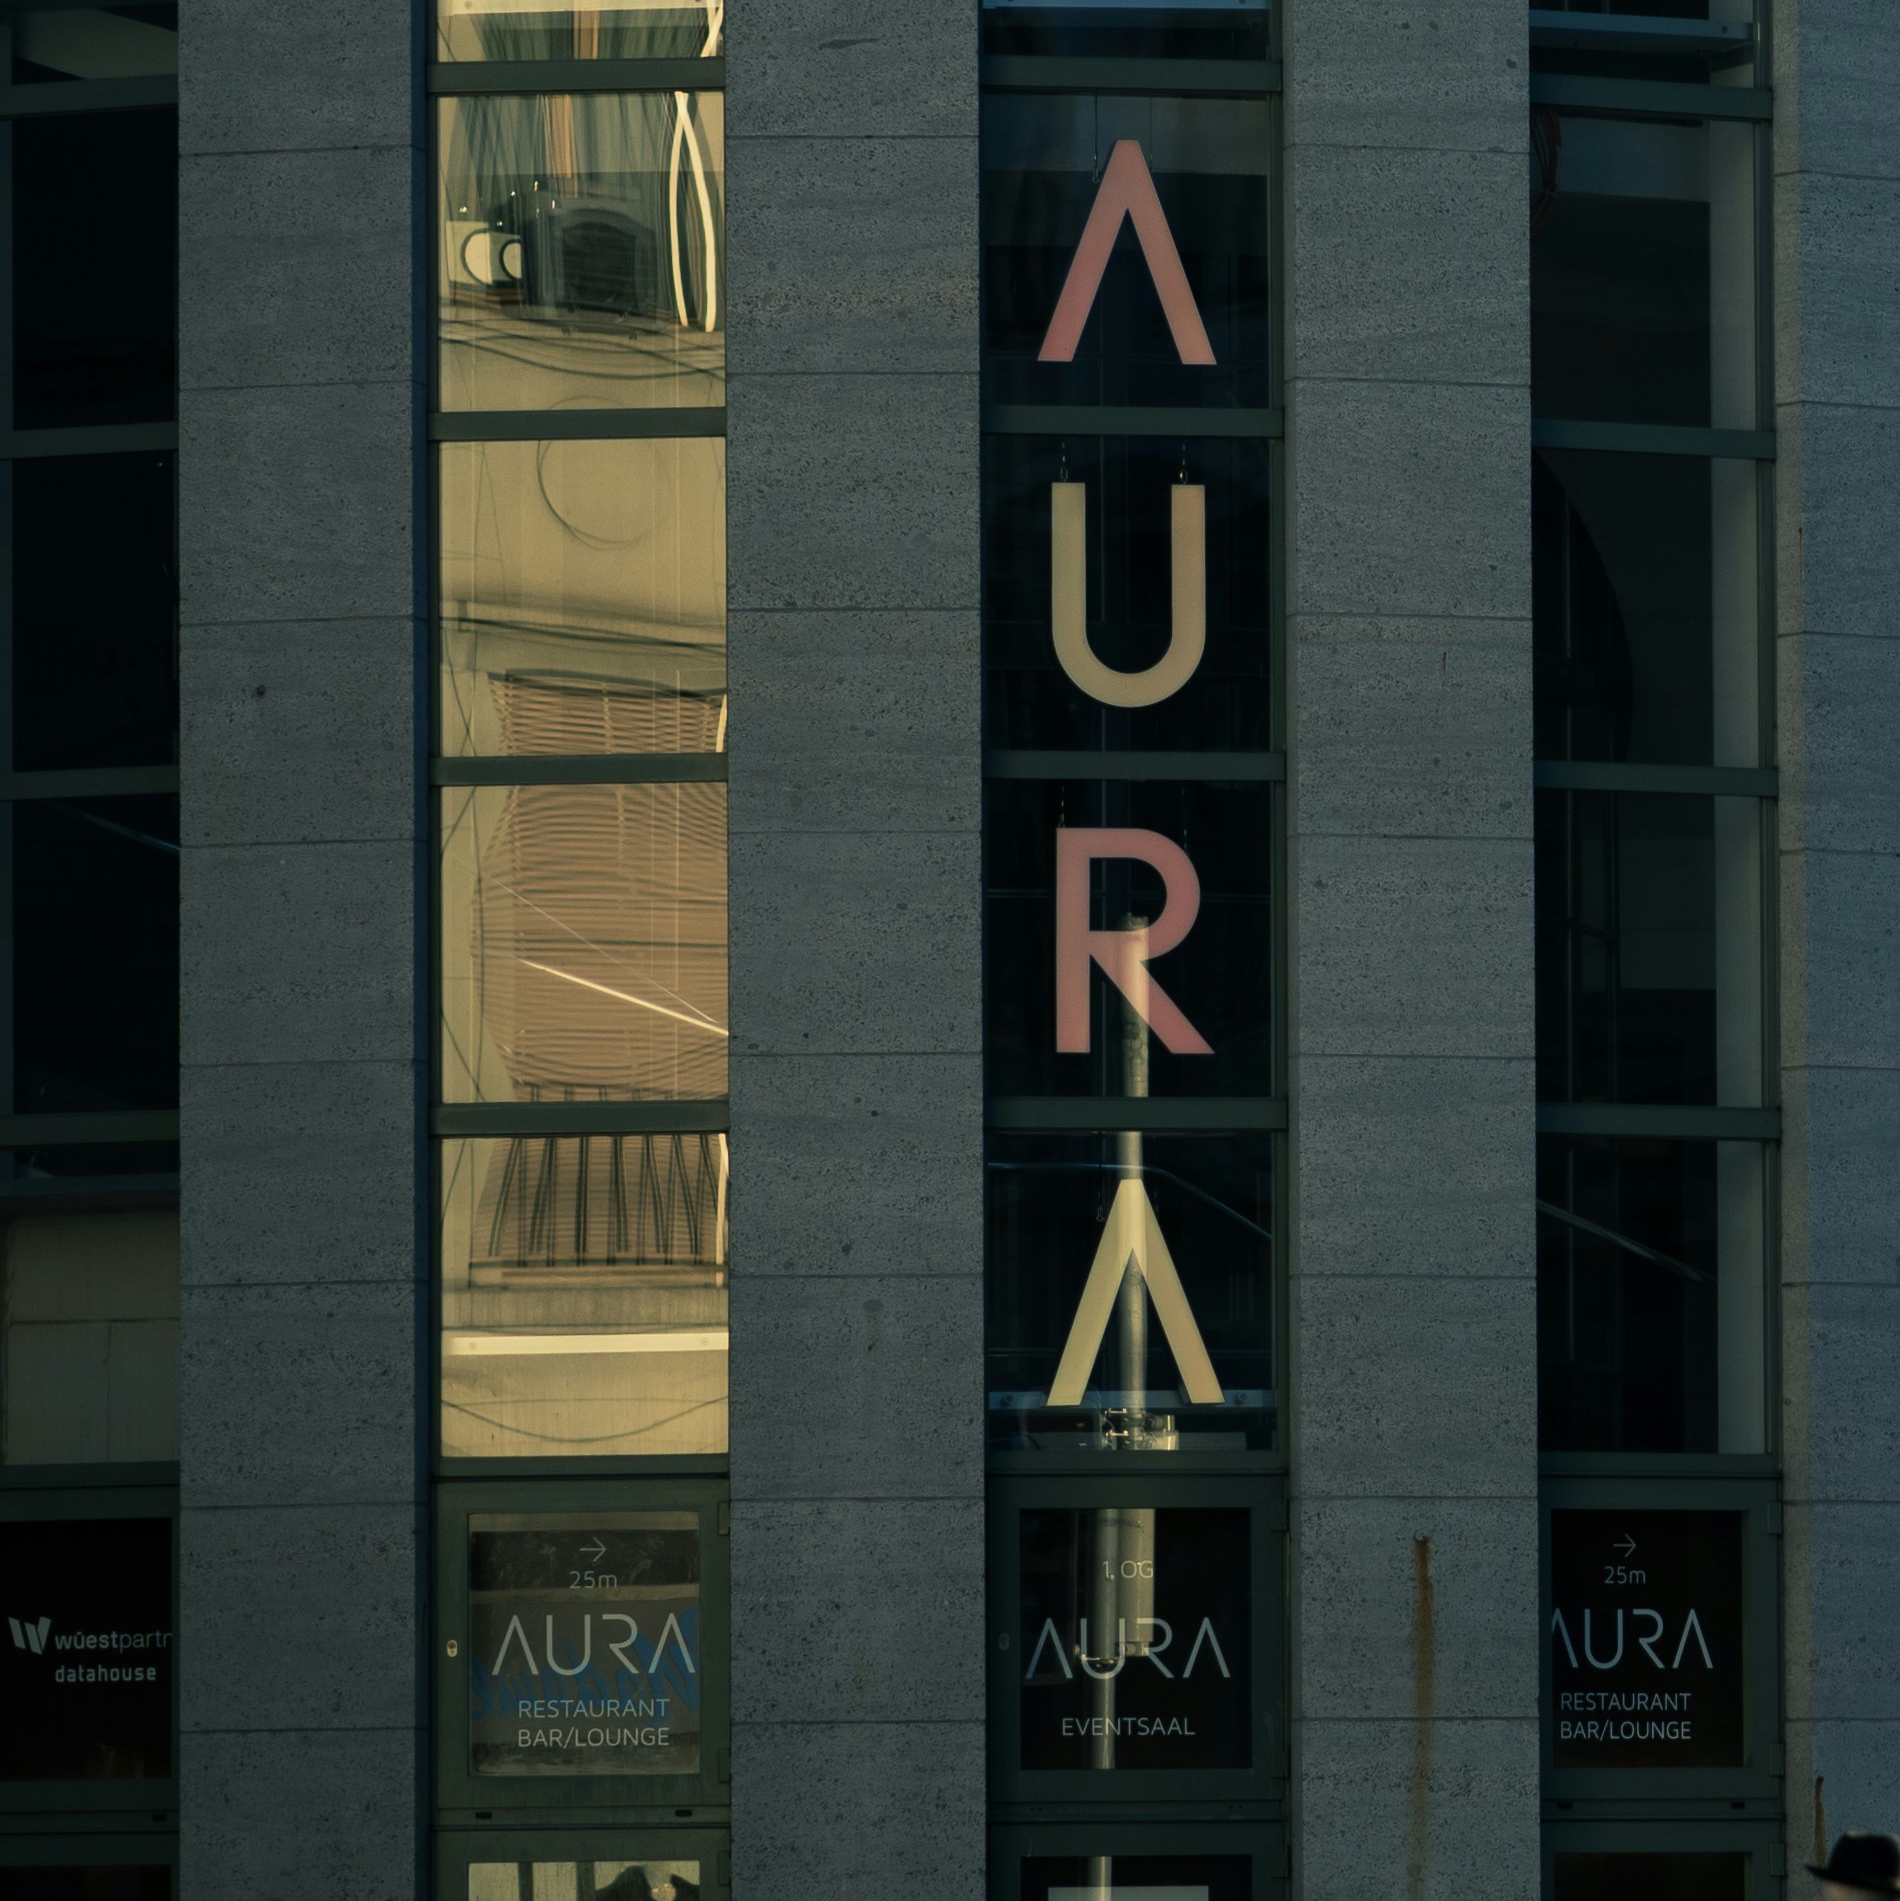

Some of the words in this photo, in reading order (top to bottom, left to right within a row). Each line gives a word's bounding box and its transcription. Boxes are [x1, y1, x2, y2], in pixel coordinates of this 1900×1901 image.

[1036, 139, 1224, 1407] AURA
[569, 1570, 618, 1590] 25m
[1120, 1560, 1154, 1580] OG
[1603, 1565, 1647, 1585] 25m
[491, 1612, 697, 1677] AURA
[1024, 1616, 1232, 1680] AURA
[1552, 1606, 1714, 1671] AURA
[54, 1663, 158, 1683] datahouse
[518, 1698, 671, 1719] RESTAURANT
[1559, 1692, 1693, 1712] RESTAURANT
[1061, 1715, 1197, 1737] EVENTSAAL
[1559, 1719, 1693, 1743] BAR/LOUNGE
[518, 1726, 671, 1749] BAR/LOUNGE
